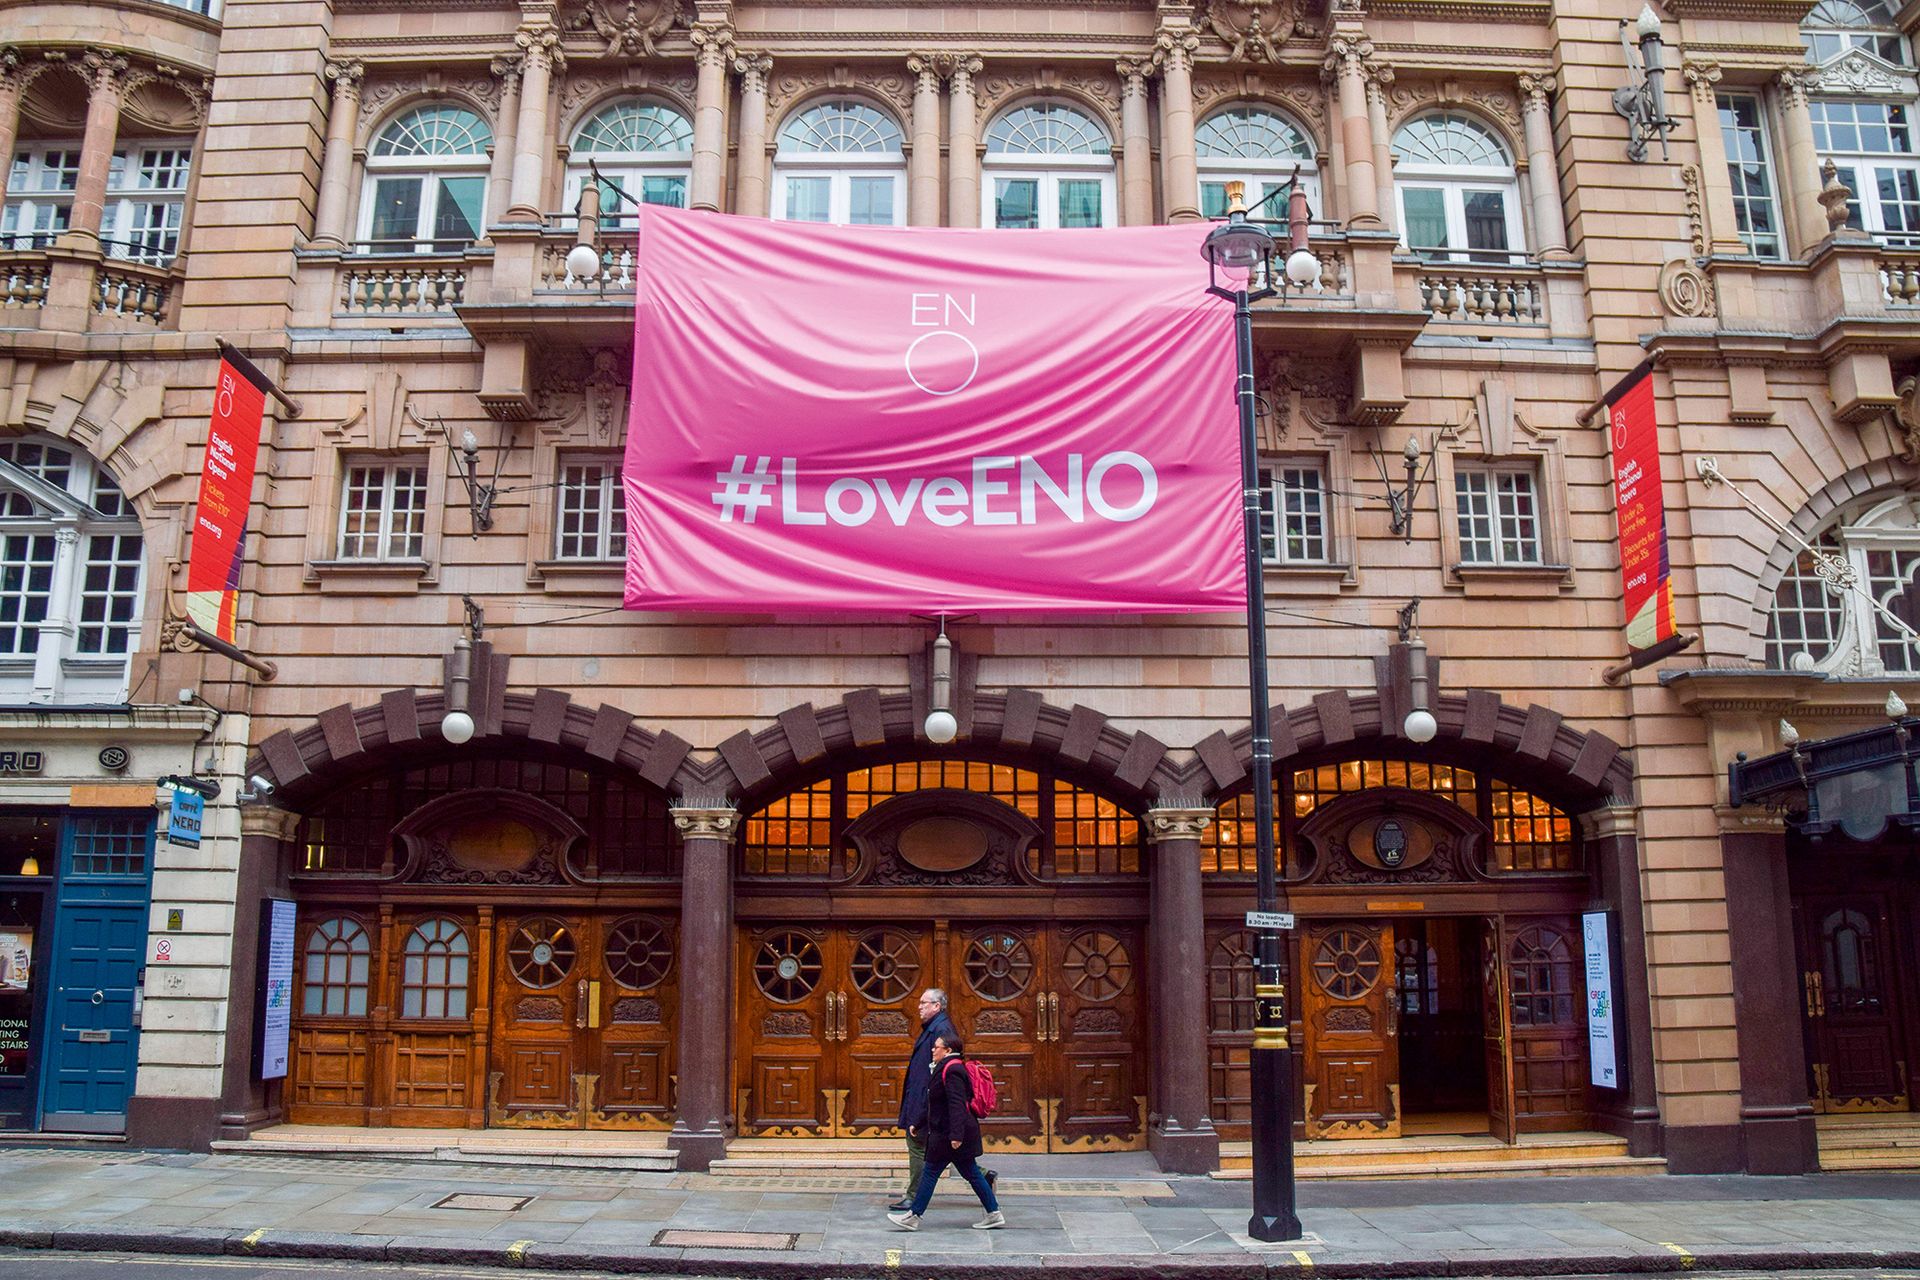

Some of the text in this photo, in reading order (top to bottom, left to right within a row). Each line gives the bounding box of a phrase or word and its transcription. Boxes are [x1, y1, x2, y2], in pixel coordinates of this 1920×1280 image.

[911, 293, 976, 326] EN
[905, 330, 979, 396] O
[223, 374, 236, 395] EN
[1615, 408, 1626, 428] EN
[212, 432, 234, 456] English
[210, 445, 237, 472] National
[208, 459, 228, 480] Opera
[1618, 459, 1637, 480] English
[1619, 468, 1643, 492] National
[205, 480, 225, 502] Tickets
[712, 450, 1160, 528] #LoveENO
[1620, 487, 1637, 505] Opera
[203, 493, 218, 511] from
[1621, 509, 1636, 525] Under
[1622, 515, 1647, 538] come free
[200, 517, 222, 539] eno.org
[1624, 531, 1656, 557] Discounts for
[1625, 555, 1640, 570] Under
[1627, 572, 1647, 590] eno.org
[173, 814, 201, 832] NERO
[270, 979, 285, 989] GREAT
[1590, 990, 1606, 1000] GREAT
[1591, 1008, 1607, 1018] OPERA
